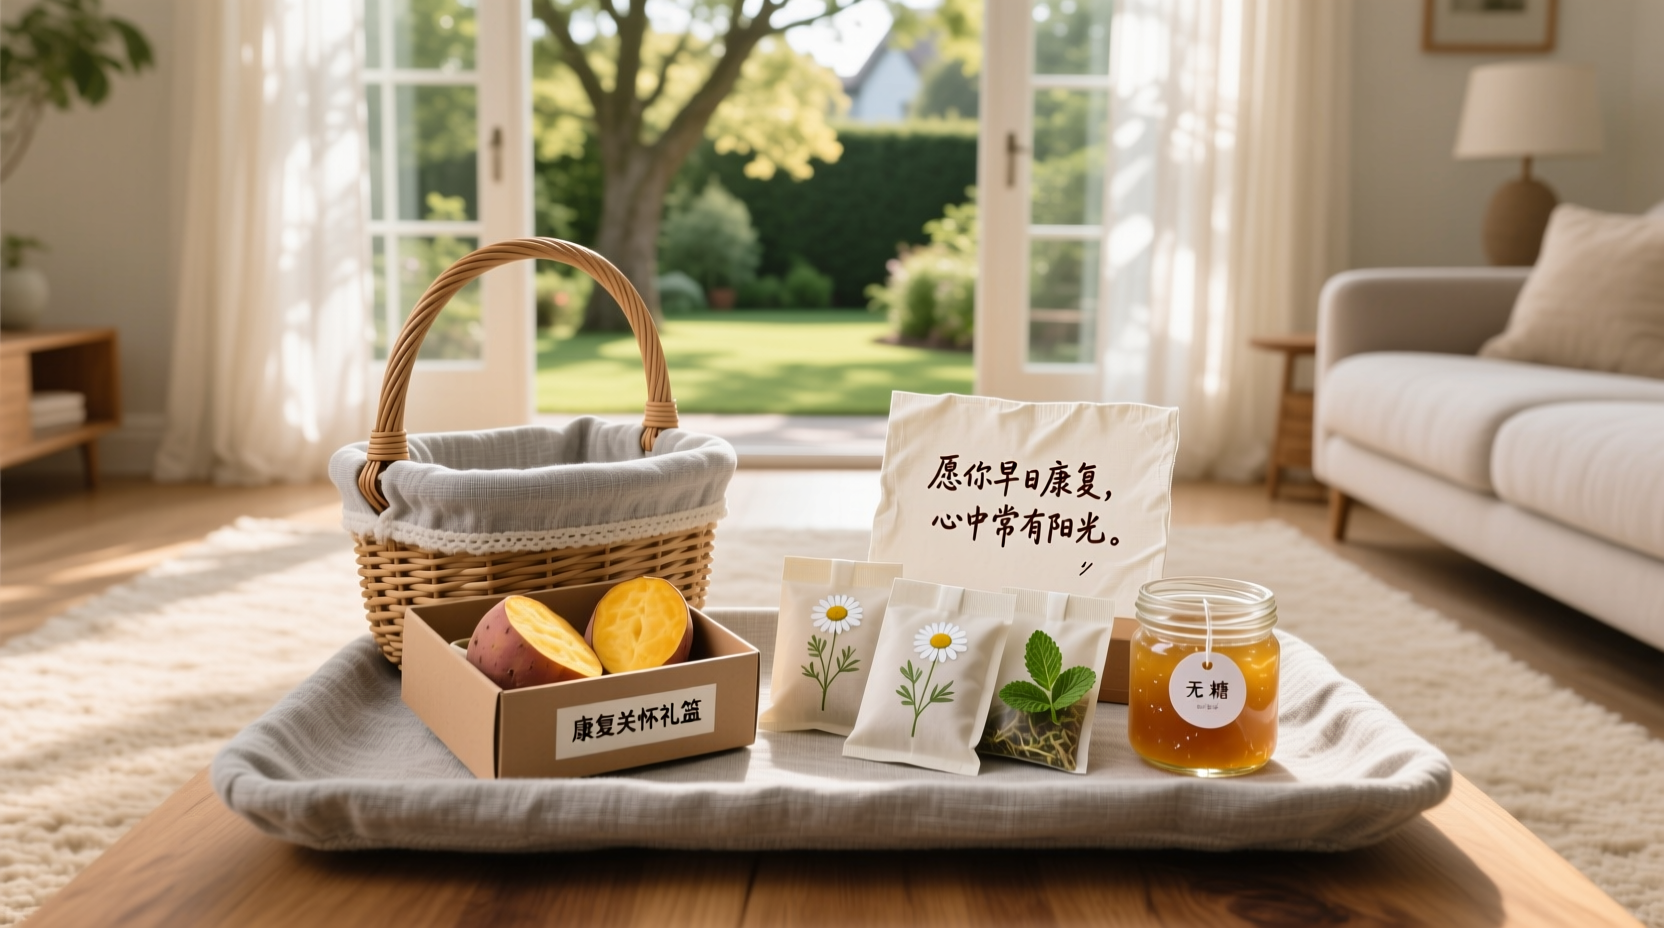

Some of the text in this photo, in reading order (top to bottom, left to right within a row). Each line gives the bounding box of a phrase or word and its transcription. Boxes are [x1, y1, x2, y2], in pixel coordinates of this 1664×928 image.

[928, 454, 1112, 502] 愿你早日康复，
[931, 504, 1120, 548] 心中常有阳光。
[1186, 680, 1229, 700] 无糖
[572, 698, 702, 743] 康复关怀礼篮
